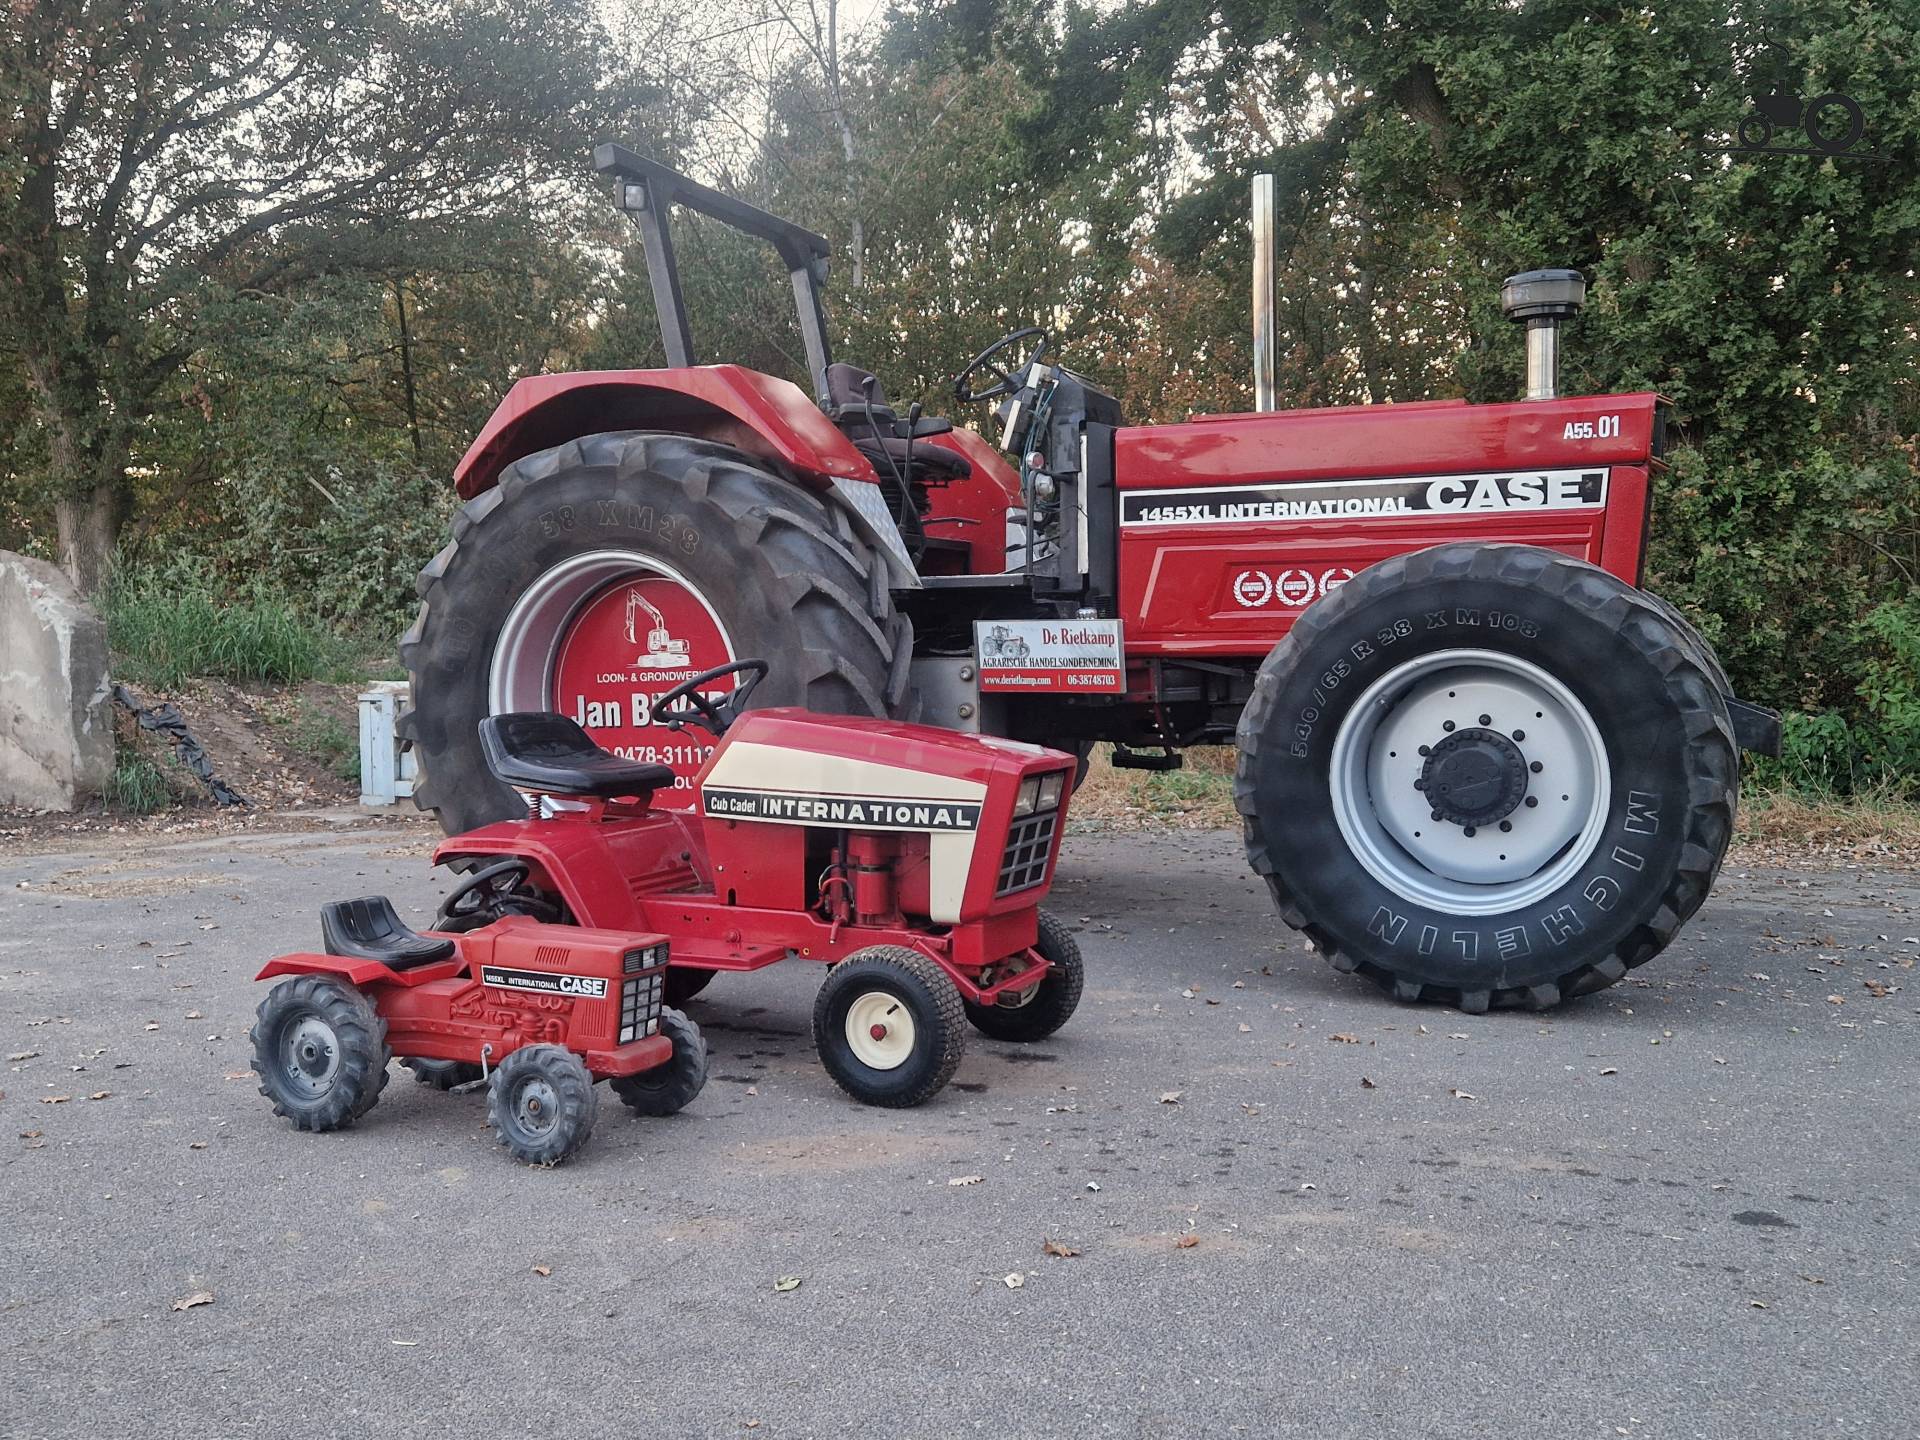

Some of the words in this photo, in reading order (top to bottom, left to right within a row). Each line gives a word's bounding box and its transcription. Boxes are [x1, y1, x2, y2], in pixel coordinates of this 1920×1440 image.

[1563, 415, 1620, 440] A55.01
[1139, 505, 1216, 522] 1455XL
[1219, 497, 1412, 520] INTERNATIONAL
[1425, 474, 1583, 511] CASE
[1042, 628, 1057, 645] De
[1061, 628, 1115, 647] Rietkamp
[982, 657, 1028, 668] AGRARISCHE
[1030, 657, 1118, 668] HANDELSONDERNEMING
[596, 673, 629, 684] LOON-
[630, 672, 638, 682] &
[984, 673, 1051, 687] www.derietkamp.com
[571, 694, 622, 728] Jan
[710, 796, 728, 812] Cub
[730, 798, 756, 813] Cadet
[762, 798, 972, 827] INTERNATIONAL
[508, 977, 559, 990] INTERNATIONAL
[559, 976, 603, 995] CASE
